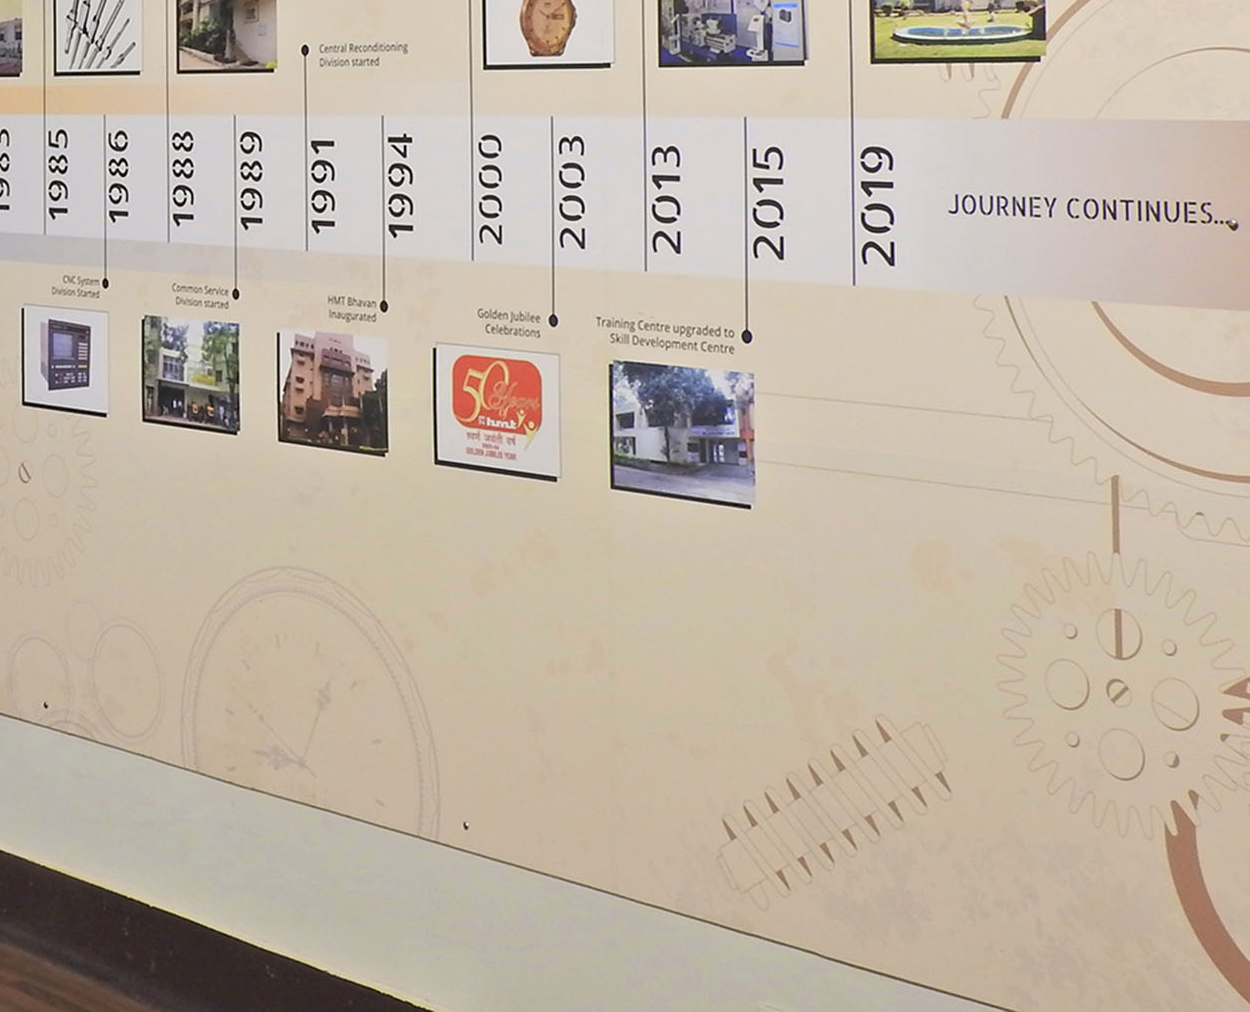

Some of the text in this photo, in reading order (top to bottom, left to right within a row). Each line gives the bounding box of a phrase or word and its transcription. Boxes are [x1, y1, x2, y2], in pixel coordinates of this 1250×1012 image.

[319, 42, 409, 54] Central Reconditioning
[319, 56, 380, 67] Division started
[49, 128, 68, 220] 1985
[109, 130, 129, 223] 1986
[172, 130, 194, 227] 1988
[240, 131, 263, 231] 1989
[388, 133, 414, 239] 1994
[311, 139, 335, 235] 1991
[478, 134, 503, 245] 2000
[559, 135, 586, 251] 2003
[652, 144, 681, 255] 2013
[752, 146, 784, 261] 2015
[860, 146, 895, 267] 2019
[948, 194, 1058, 219] JOURNEY
[52, 287, 75, 297] Division
[62, 275, 100, 287] CNC System
[172, 283, 229, 297] Common Service
[175, 295, 229, 310] Division started
[327, 295, 377, 308] HMT Bhavan
[329, 309, 377, 323] Inaugurated
[477, 308, 541, 324] Golden Jubilee
[596, 316, 735, 339] Training Centre upgraded to
[485, 324, 541, 339] Celebrations
[610, 333, 735, 354] Skill Development Centre
[463, 361, 510, 423] 50
